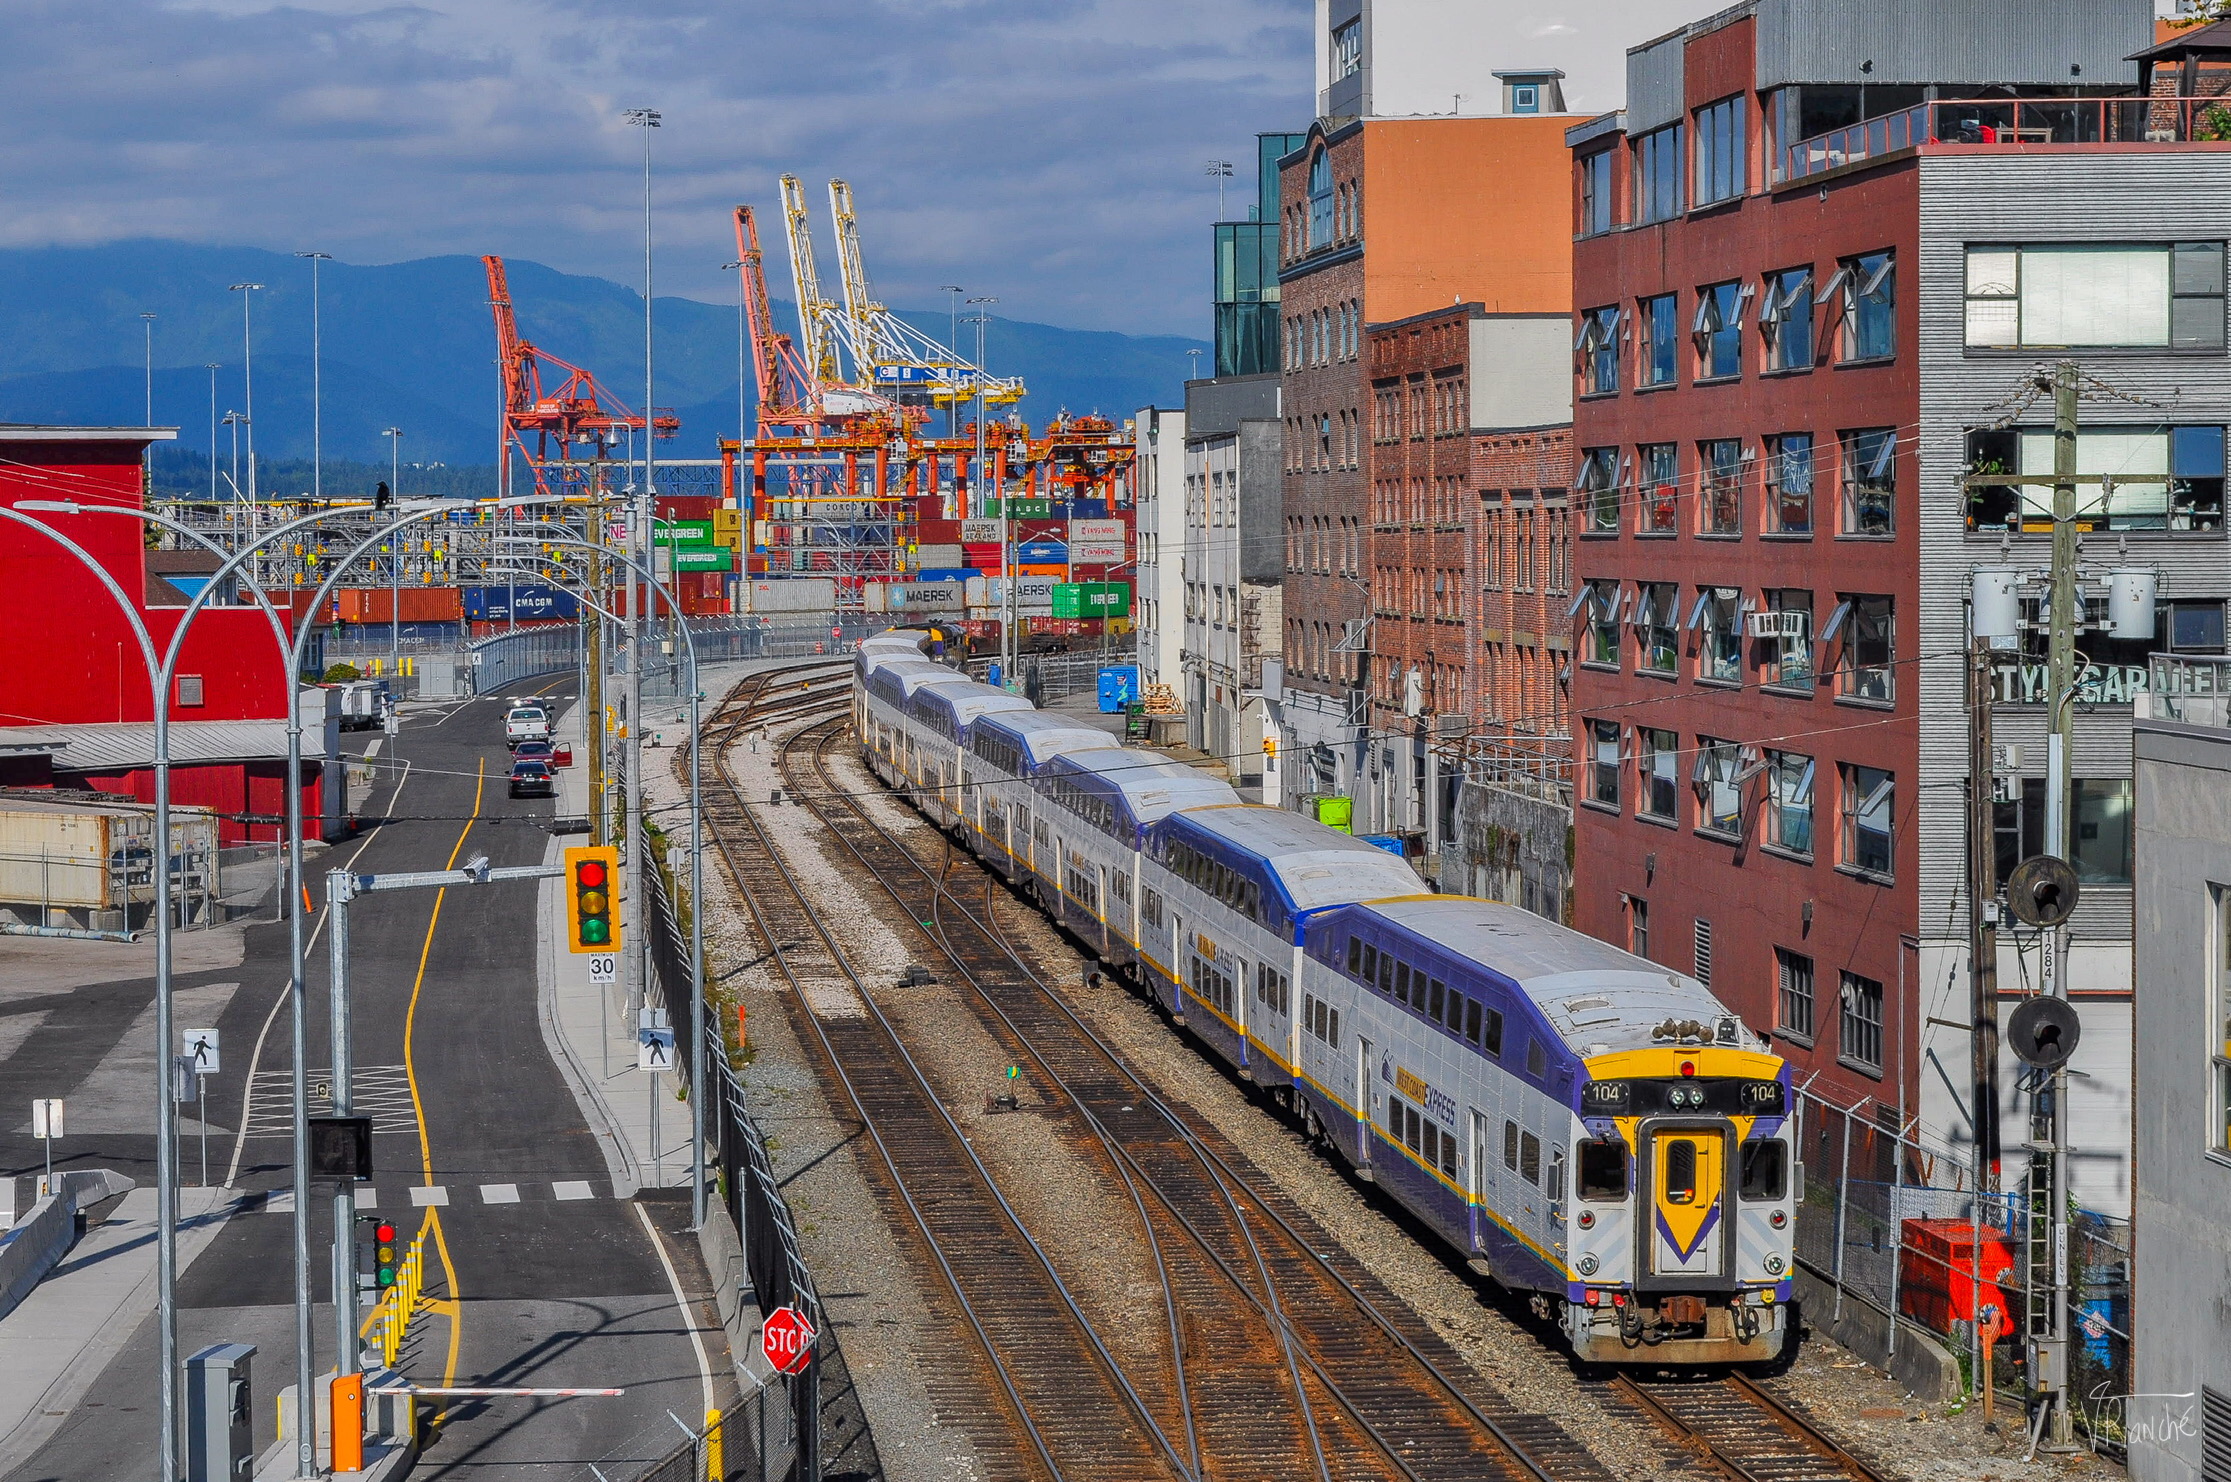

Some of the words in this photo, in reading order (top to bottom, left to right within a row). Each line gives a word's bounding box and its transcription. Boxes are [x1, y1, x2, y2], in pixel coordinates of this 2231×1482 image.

[826, 503, 857, 511] COSCO
[965, 524, 996, 532] MAERSK
[515, 598, 534, 607] CMA
[535, 598, 552, 607] CGM
[906, 589, 953, 602] MAERSK
[2044, 931, 2052, 979] 1284
[591, 958, 614, 974] 30
[1592, 1085, 1620, 1101] 104
[1751, 1085, 1776, 1101] 104
[1424, 1083, 1456, 1126] EXPRESS
[767, 1326, 809, 1354] STOP
